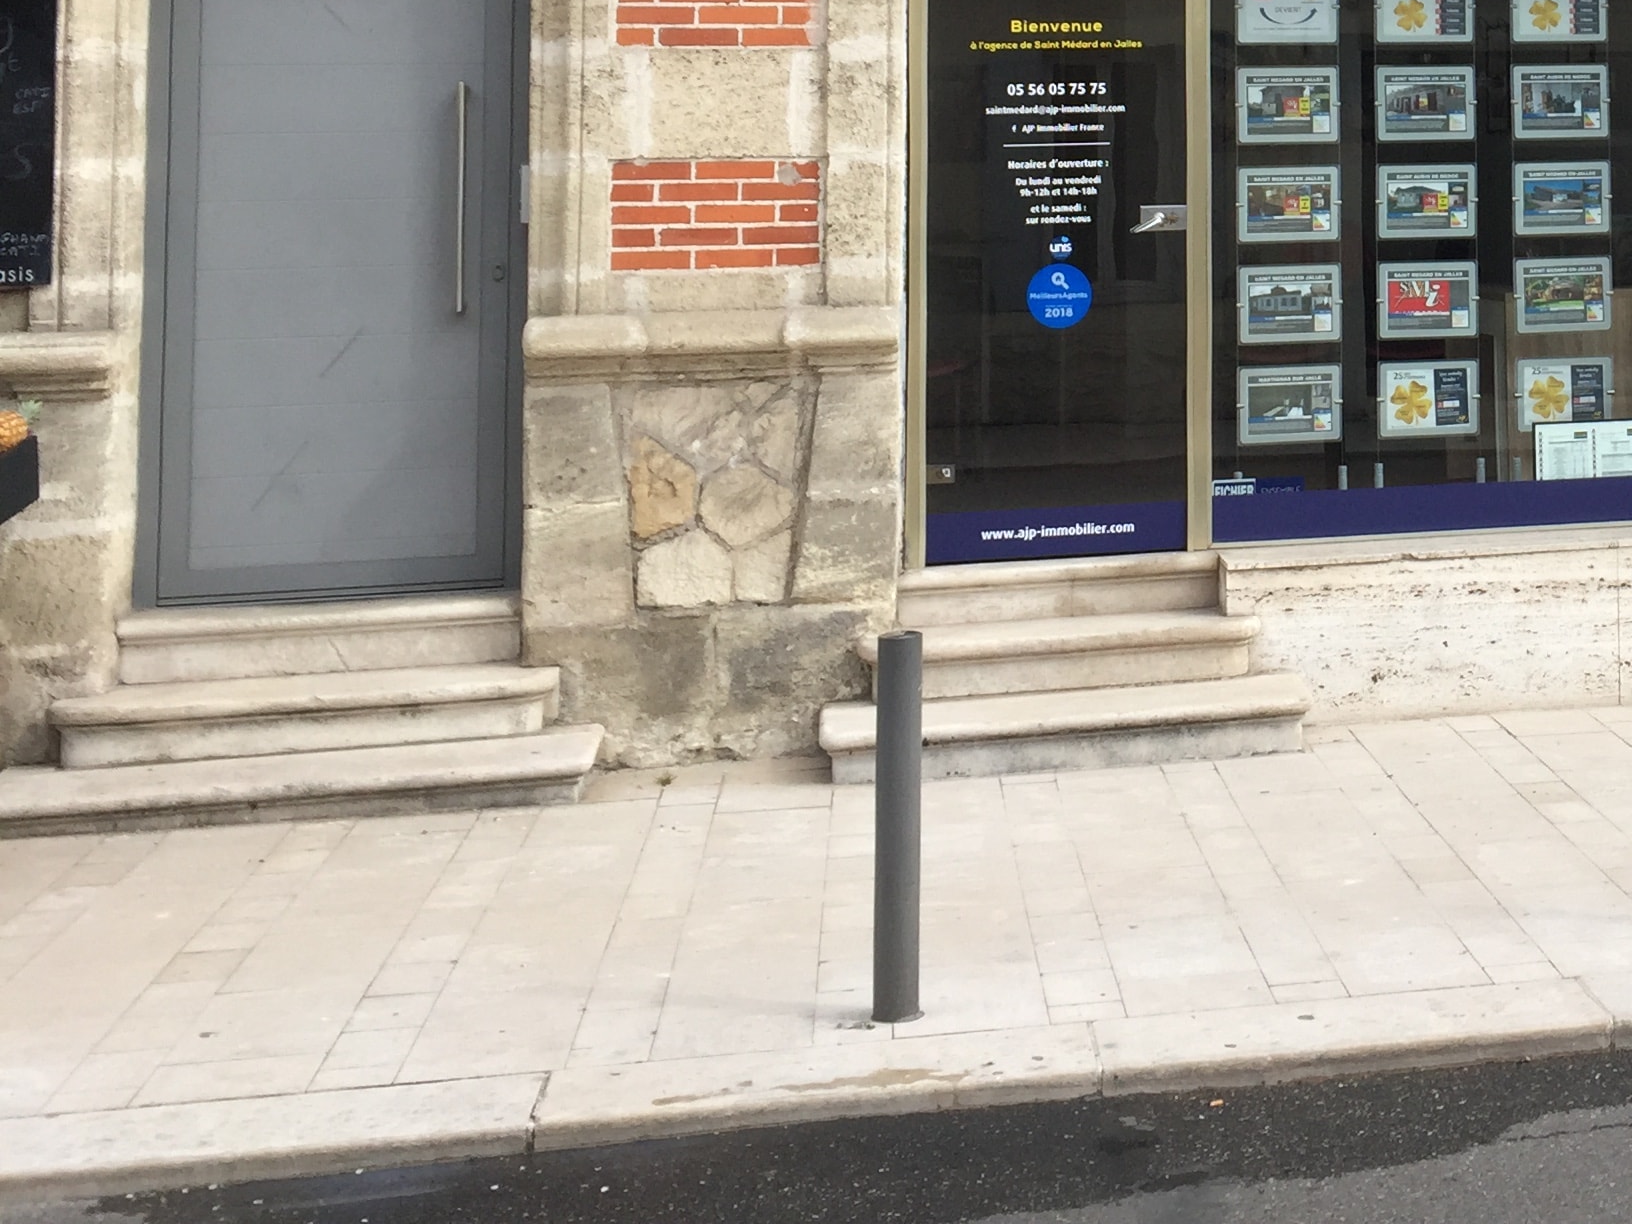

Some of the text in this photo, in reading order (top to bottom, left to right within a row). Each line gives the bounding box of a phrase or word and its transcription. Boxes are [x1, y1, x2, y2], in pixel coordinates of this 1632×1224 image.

[1010, 20, 1103, 33] Bienvenue
[970, 39, 1143, 53] à l'agence de Saint Médard en Jalles
[1007, 82, 1107, 96] 05 56 05 75 75
[1079, 123, 1104, 132] France
[1008, 160, 1047, 170] Horaires
[1049, 158, 1104, 169] d'ouverture
[1015, 178, 1026, 186] Du
[1028, 176, 1050, 186] lundi
[1064, 175, 1102, 185] vendredi
[1020, 188, 1050, 197] 9h-12h
[1052, 188, 1061, 196] et
[1030, 204, 1039, 213] et
[1041, 204, 1049, 213] le
[1052, 203, 1082, 213] samedi
[1025, 214, 1092, 225] sur rendez-vous
[1045, 307, 1074, 318] 2018
[981, 522, 1135, 540] www.ajp-immobilier.com
